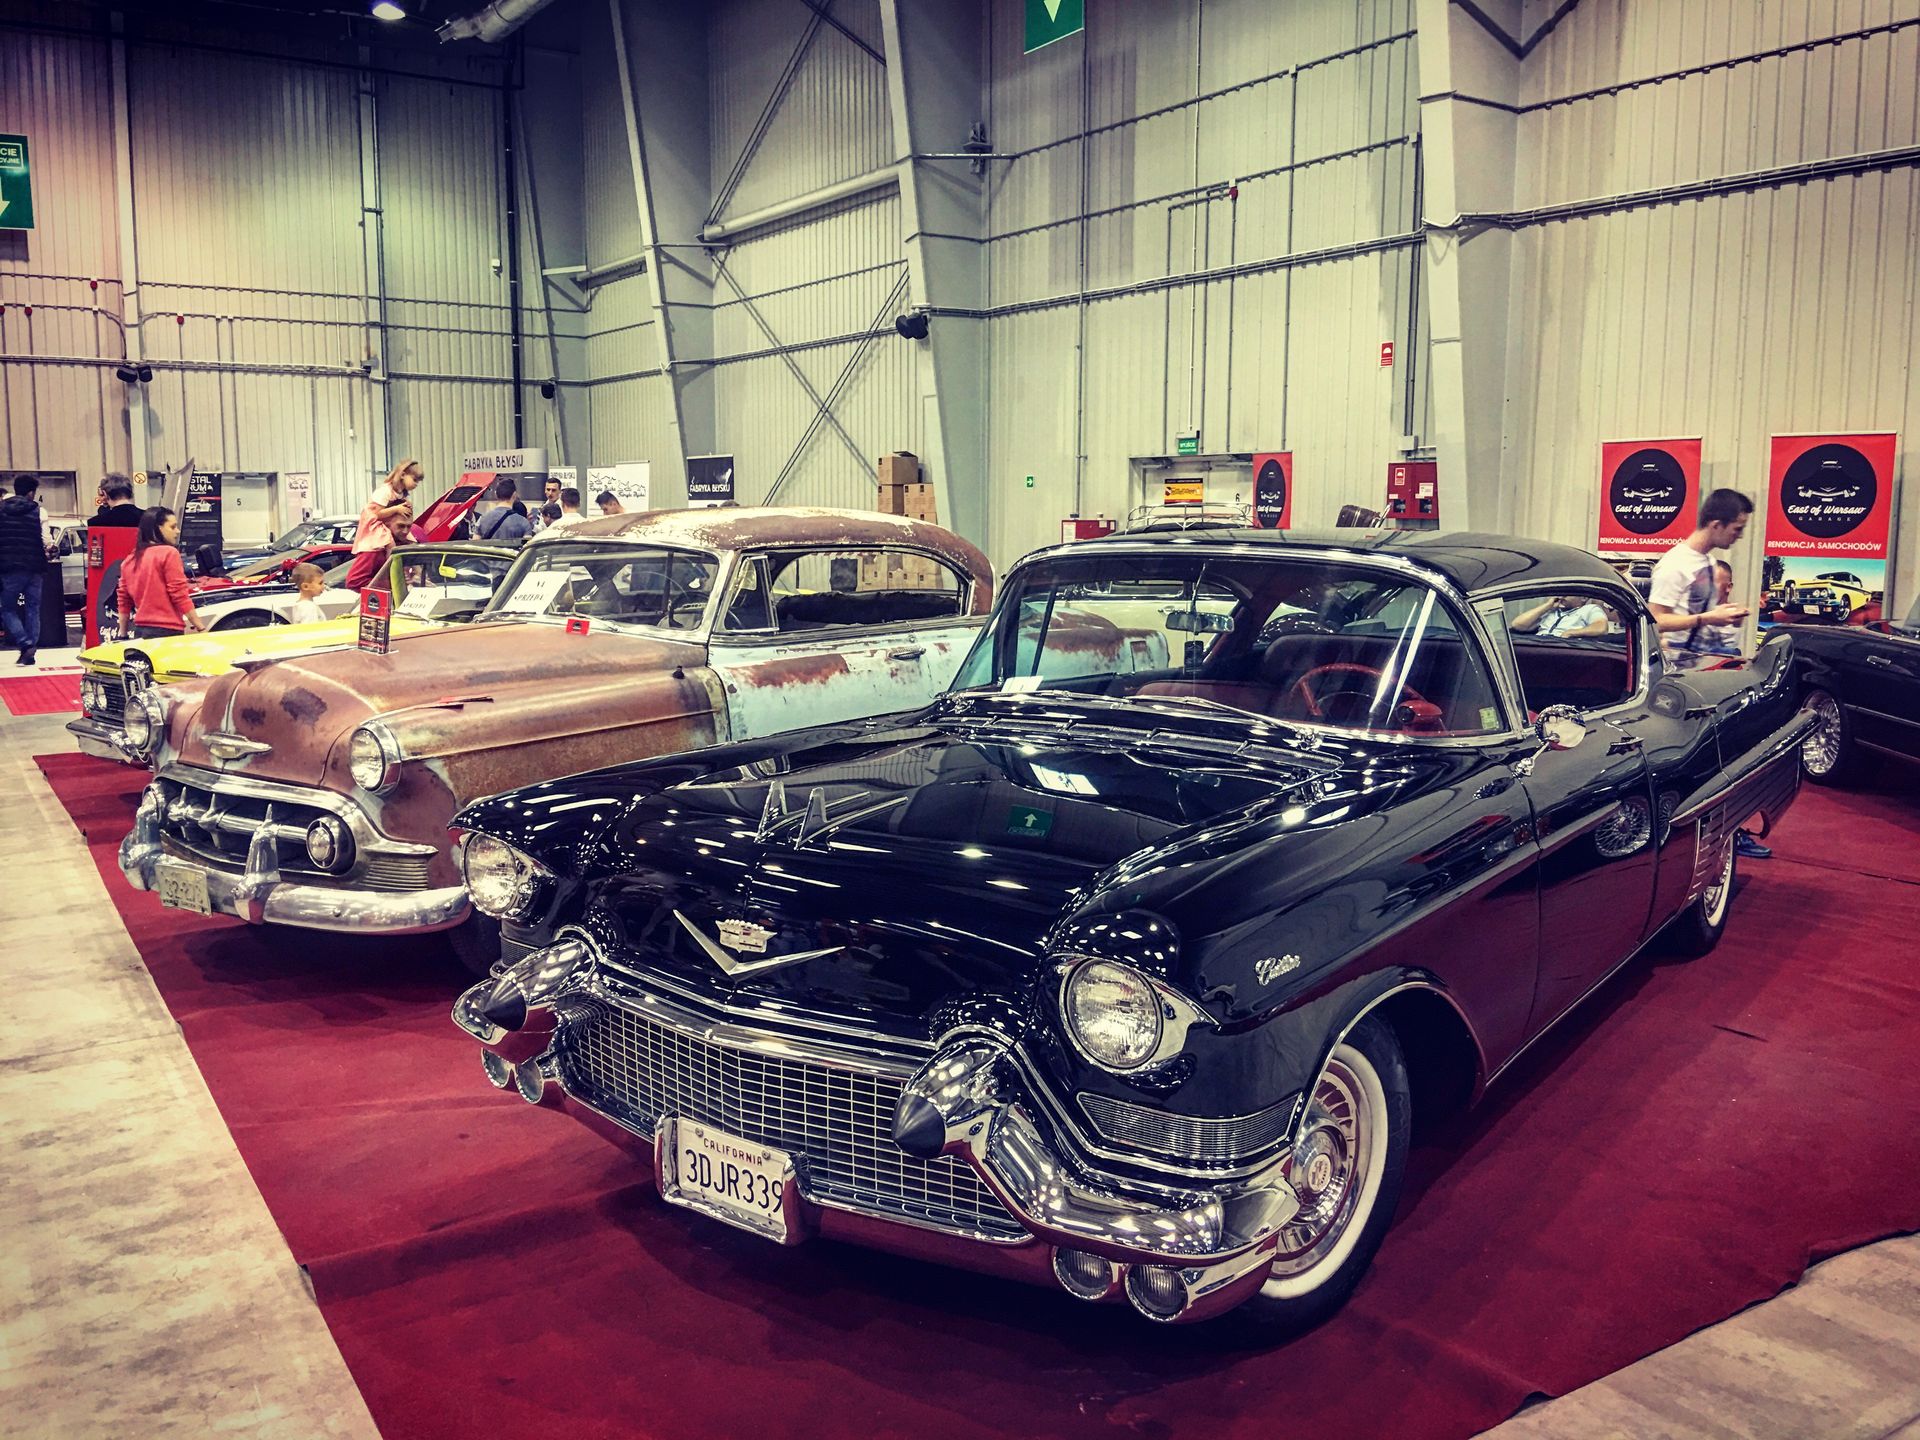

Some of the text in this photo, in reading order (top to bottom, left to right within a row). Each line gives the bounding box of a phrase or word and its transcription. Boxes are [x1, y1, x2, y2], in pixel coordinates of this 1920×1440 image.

[464, 454, 523, 470] FABRYKA BŁYSKU
[236, 498, 242, 506] 5
[1615, 504, 1678, 514] East of Warsaw
[1787, 505, 1867, 516] East of Warsaw
[1767, 541, 1881, 551] RENOWACJA SAMOCHODÓW
[703, 1137, 763, 1167] CALIFORNIA
[685, 1149, 783, 1213] 3DJR339
